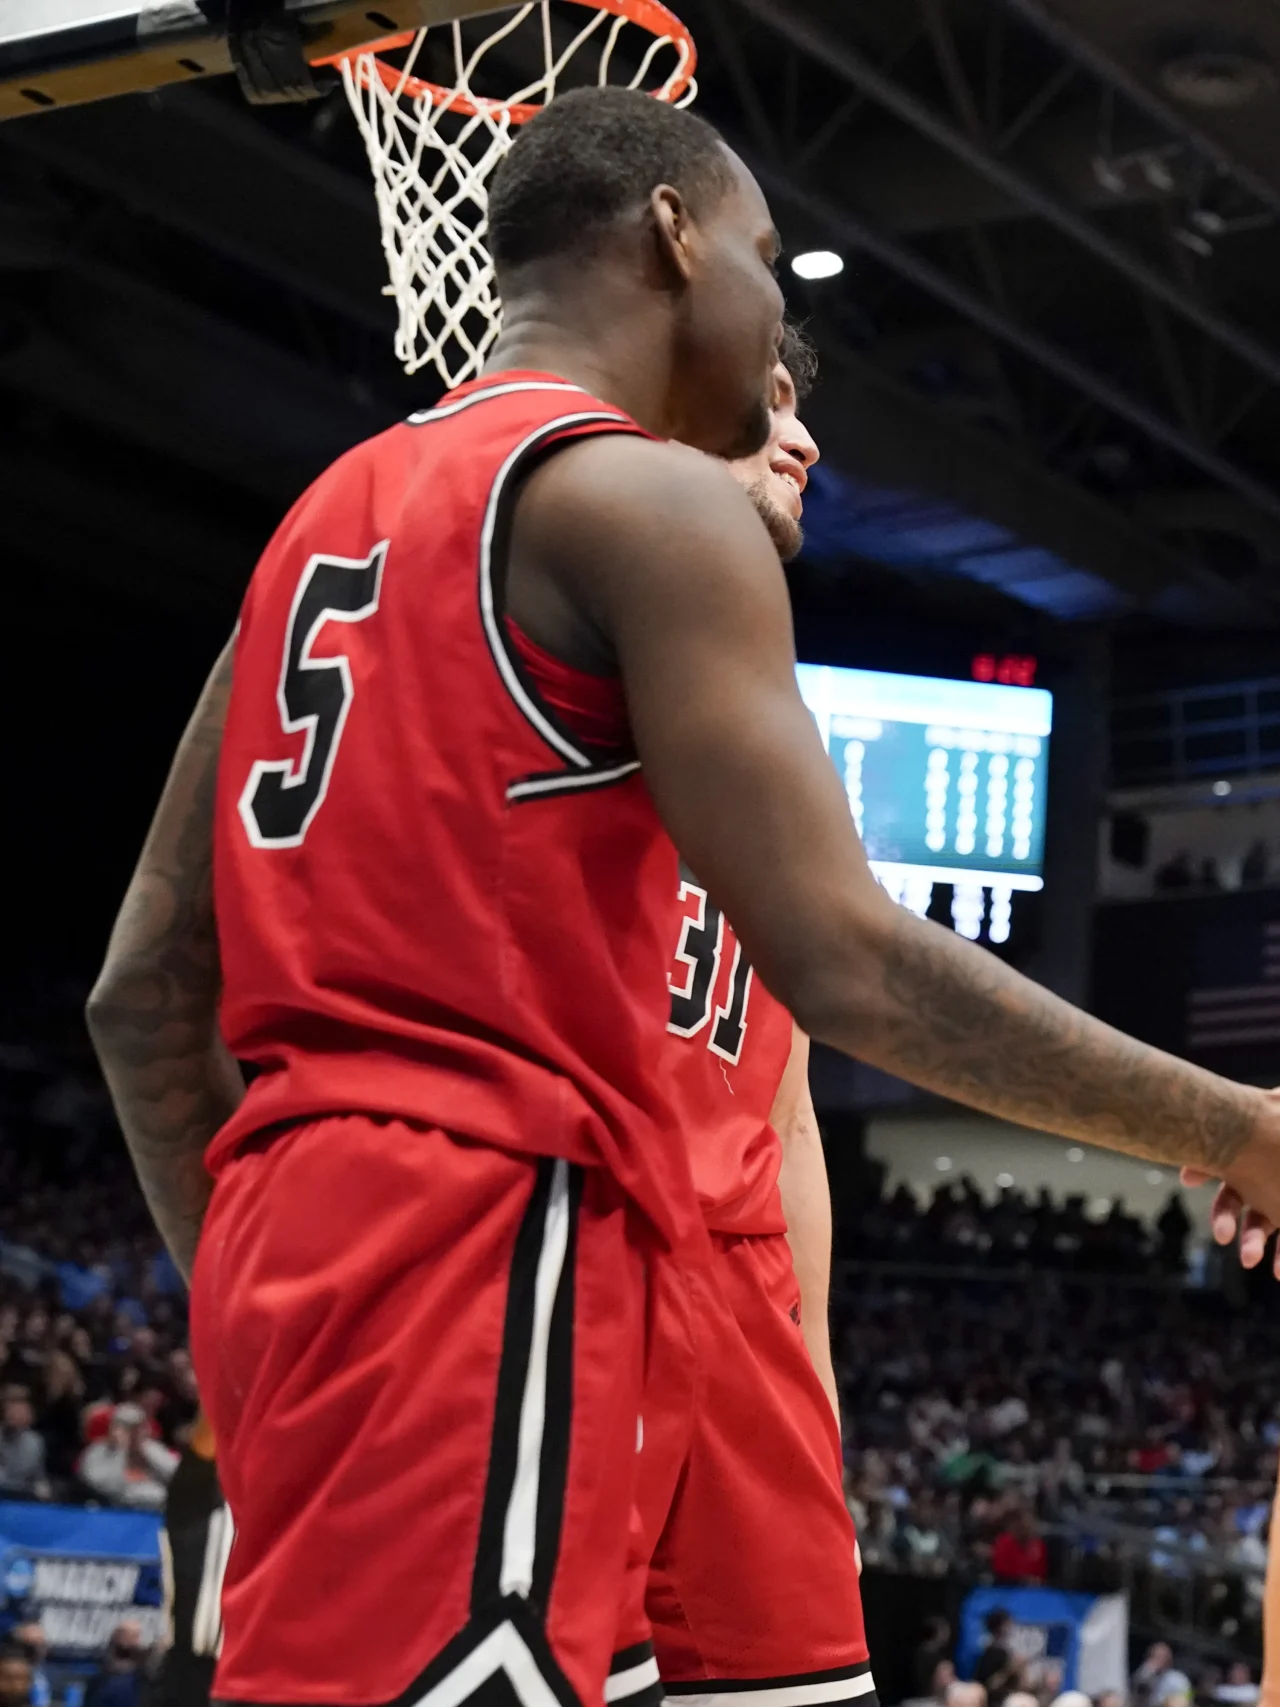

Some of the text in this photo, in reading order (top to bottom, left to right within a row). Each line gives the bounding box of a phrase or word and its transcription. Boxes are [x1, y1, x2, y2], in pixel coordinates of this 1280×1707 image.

[238, 539, 391, 849] 5
[665, 880, 754, 1067] 31
[33, 1559, 140, 1602] MARCH
